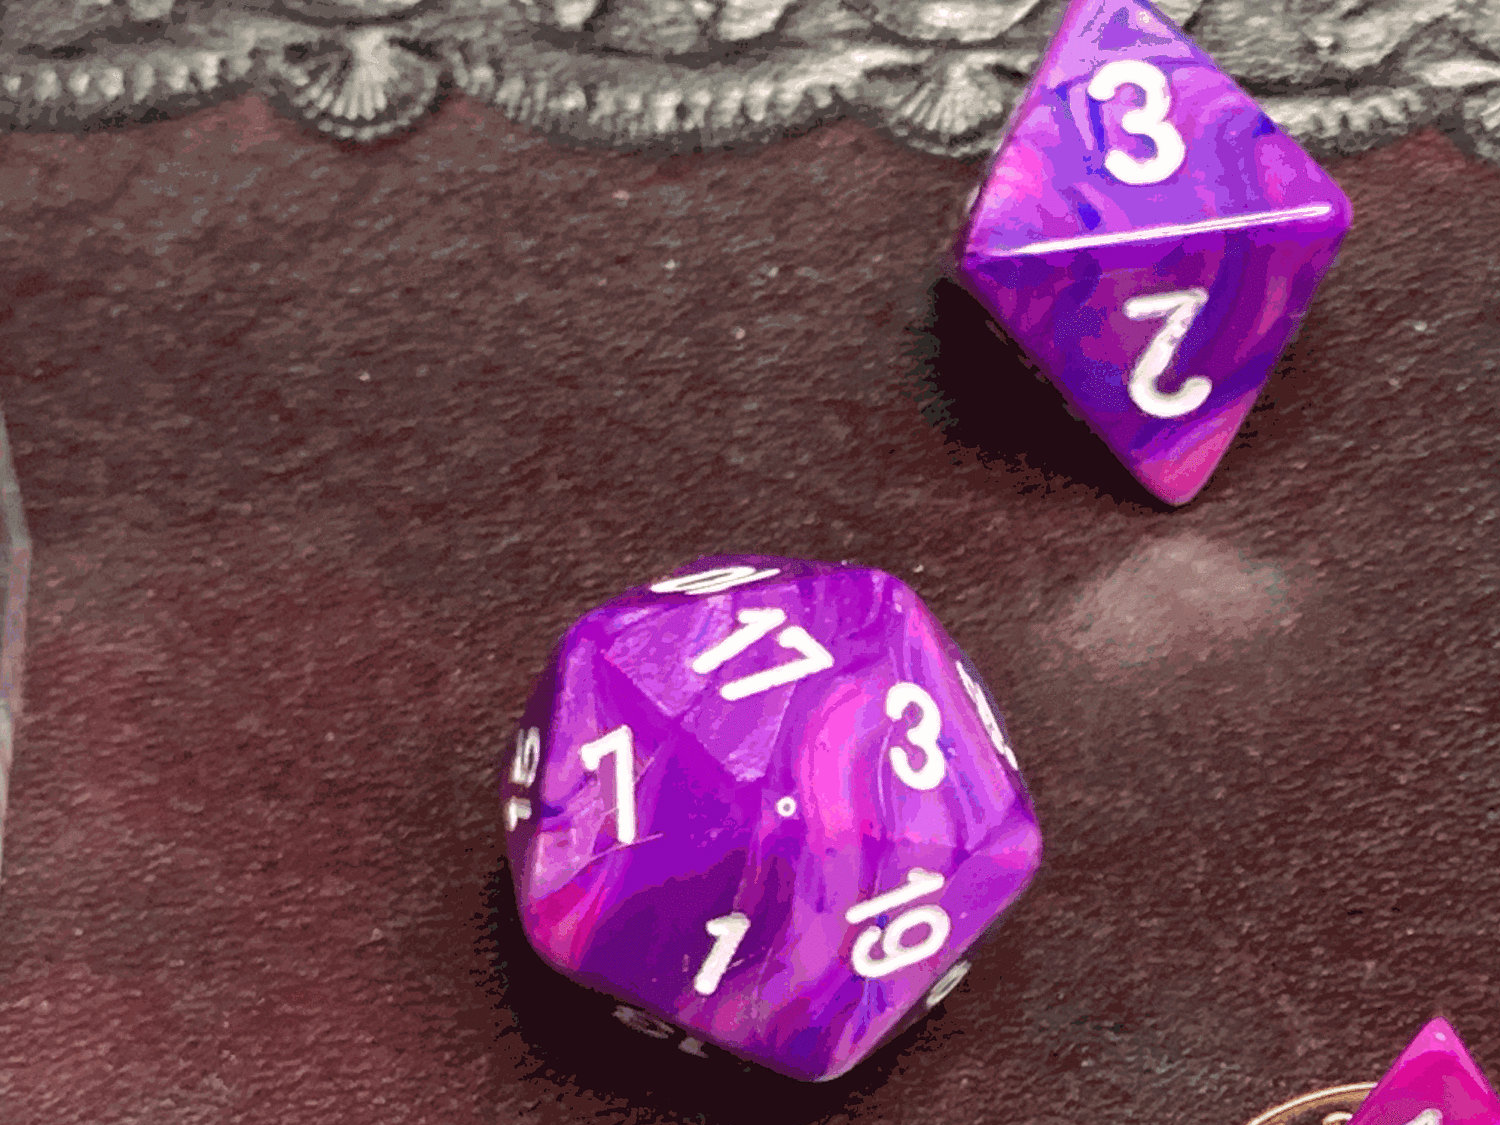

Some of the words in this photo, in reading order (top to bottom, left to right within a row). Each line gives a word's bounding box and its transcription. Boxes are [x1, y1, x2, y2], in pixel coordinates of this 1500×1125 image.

[1086, 57, 1186, 185] 3
[1125, 288, 1213, 419] 2
[688, 606, 835, 702] 17
[577, 724, 637, 846] 7
[884, 680, 948, 792] 3
[693, 915, 750, 996] 1
[844, 866, 951, 979] 19
